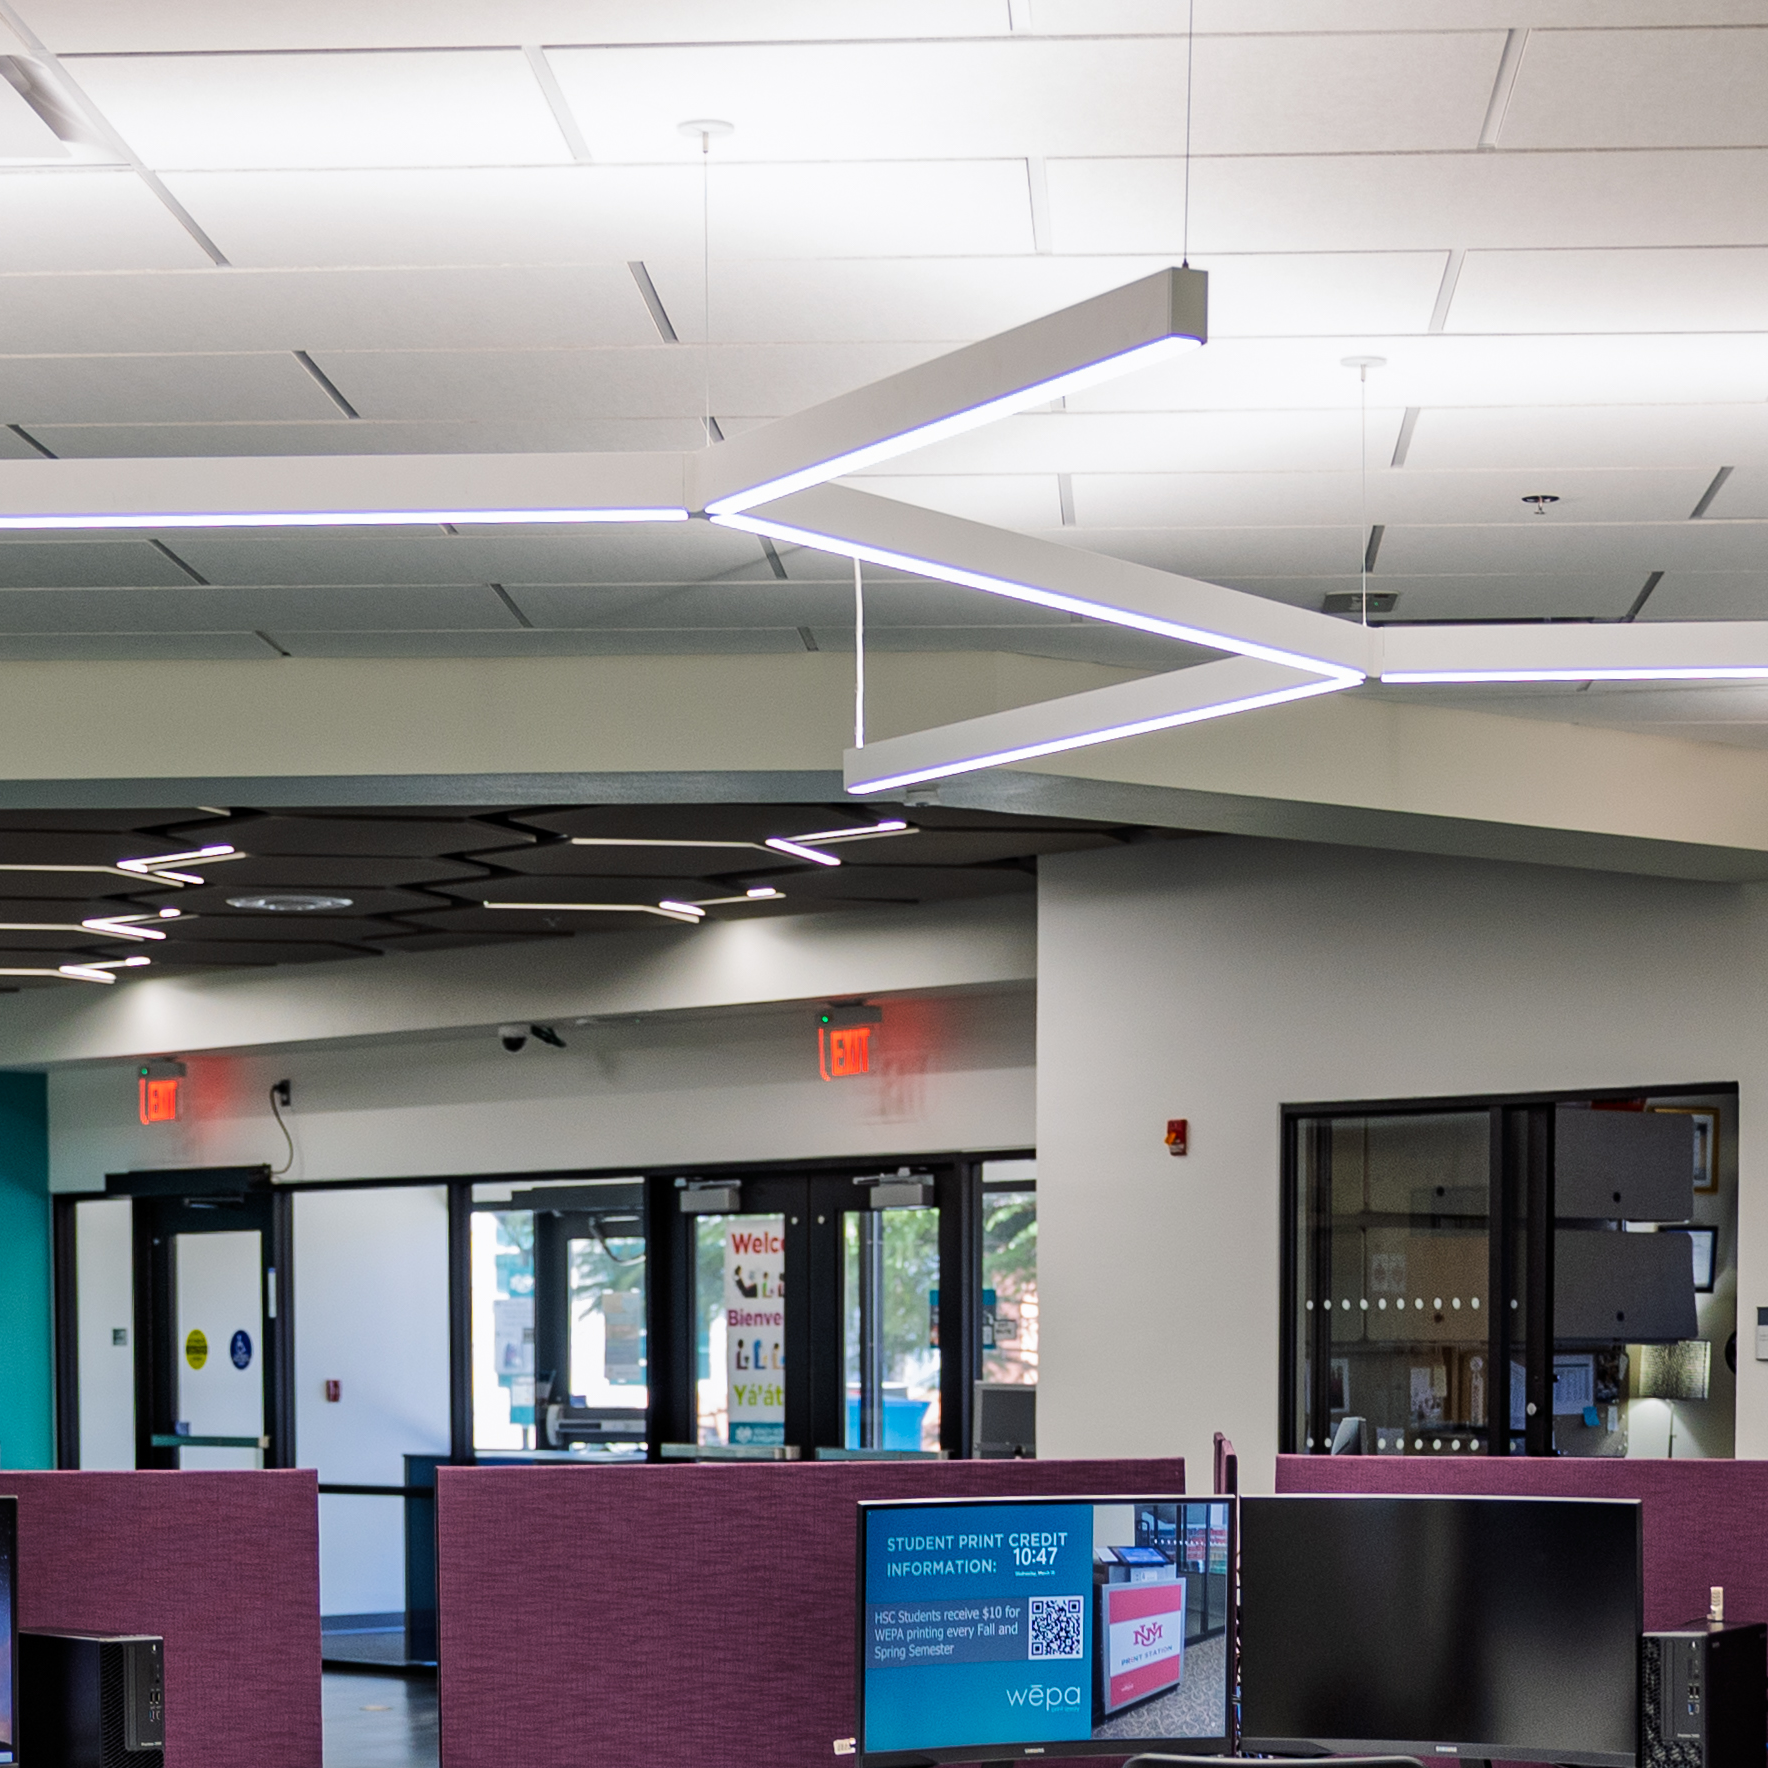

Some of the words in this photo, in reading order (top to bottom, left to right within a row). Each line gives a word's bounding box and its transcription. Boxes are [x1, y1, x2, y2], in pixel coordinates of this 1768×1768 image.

[830, 1027, 870, 1076] EXIT
[887, 1535, 955, 1552] STUDENT
[958, 1533, 1004, 1549] PRINT
[1008, 1532, 1068, 1548] CREDIT
[1013, 1547, 1058, 1566] 10:47
[887, 1559, 997, 1577] INFORMATION:
[874, 1611, 895, 1625] HSC
[898, 1608, 941, 1624] Students
[943, 1607, 979, 1621] receive
[982, 1605, 1002, 1621] $10
[1005, 1604, 1021, 1619] for
[874, 1627, 904, 1642] WEPA
[907, 1625, 944, 1642] printing
[947, 1625, 975, 1639] every
[977, 1622, 995, 1636] Fall
[998, 1621, 1018, 1636] and
[874, 1645, 906, 1661] Spring
[909, 1643, 955, 1657] Semester
[1006, 1684, 1081, 1711] wēpa
